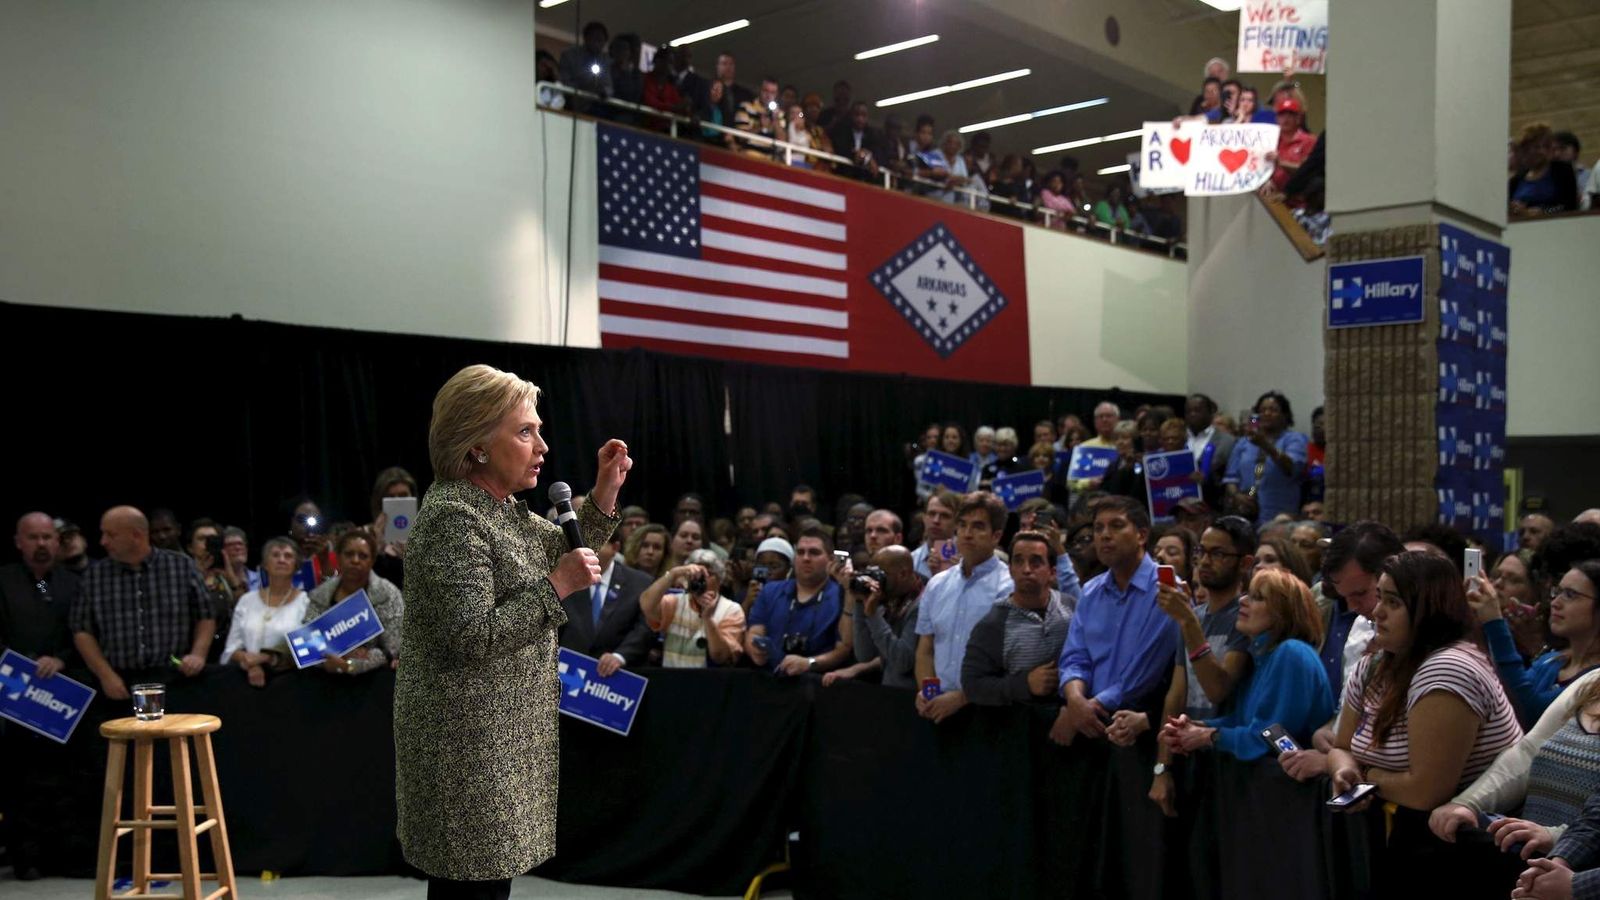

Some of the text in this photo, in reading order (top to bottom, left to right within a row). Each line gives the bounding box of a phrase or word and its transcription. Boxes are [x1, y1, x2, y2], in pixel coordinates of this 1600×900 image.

[916, 275, 967, 298] ARKANSAS
[1364, 281, 1420, 299] Hillary
[325, 608, 369, 641] Hillary
[24, 684, 79, 720] Hillary
[583, 679, 635, 711] Hillary
